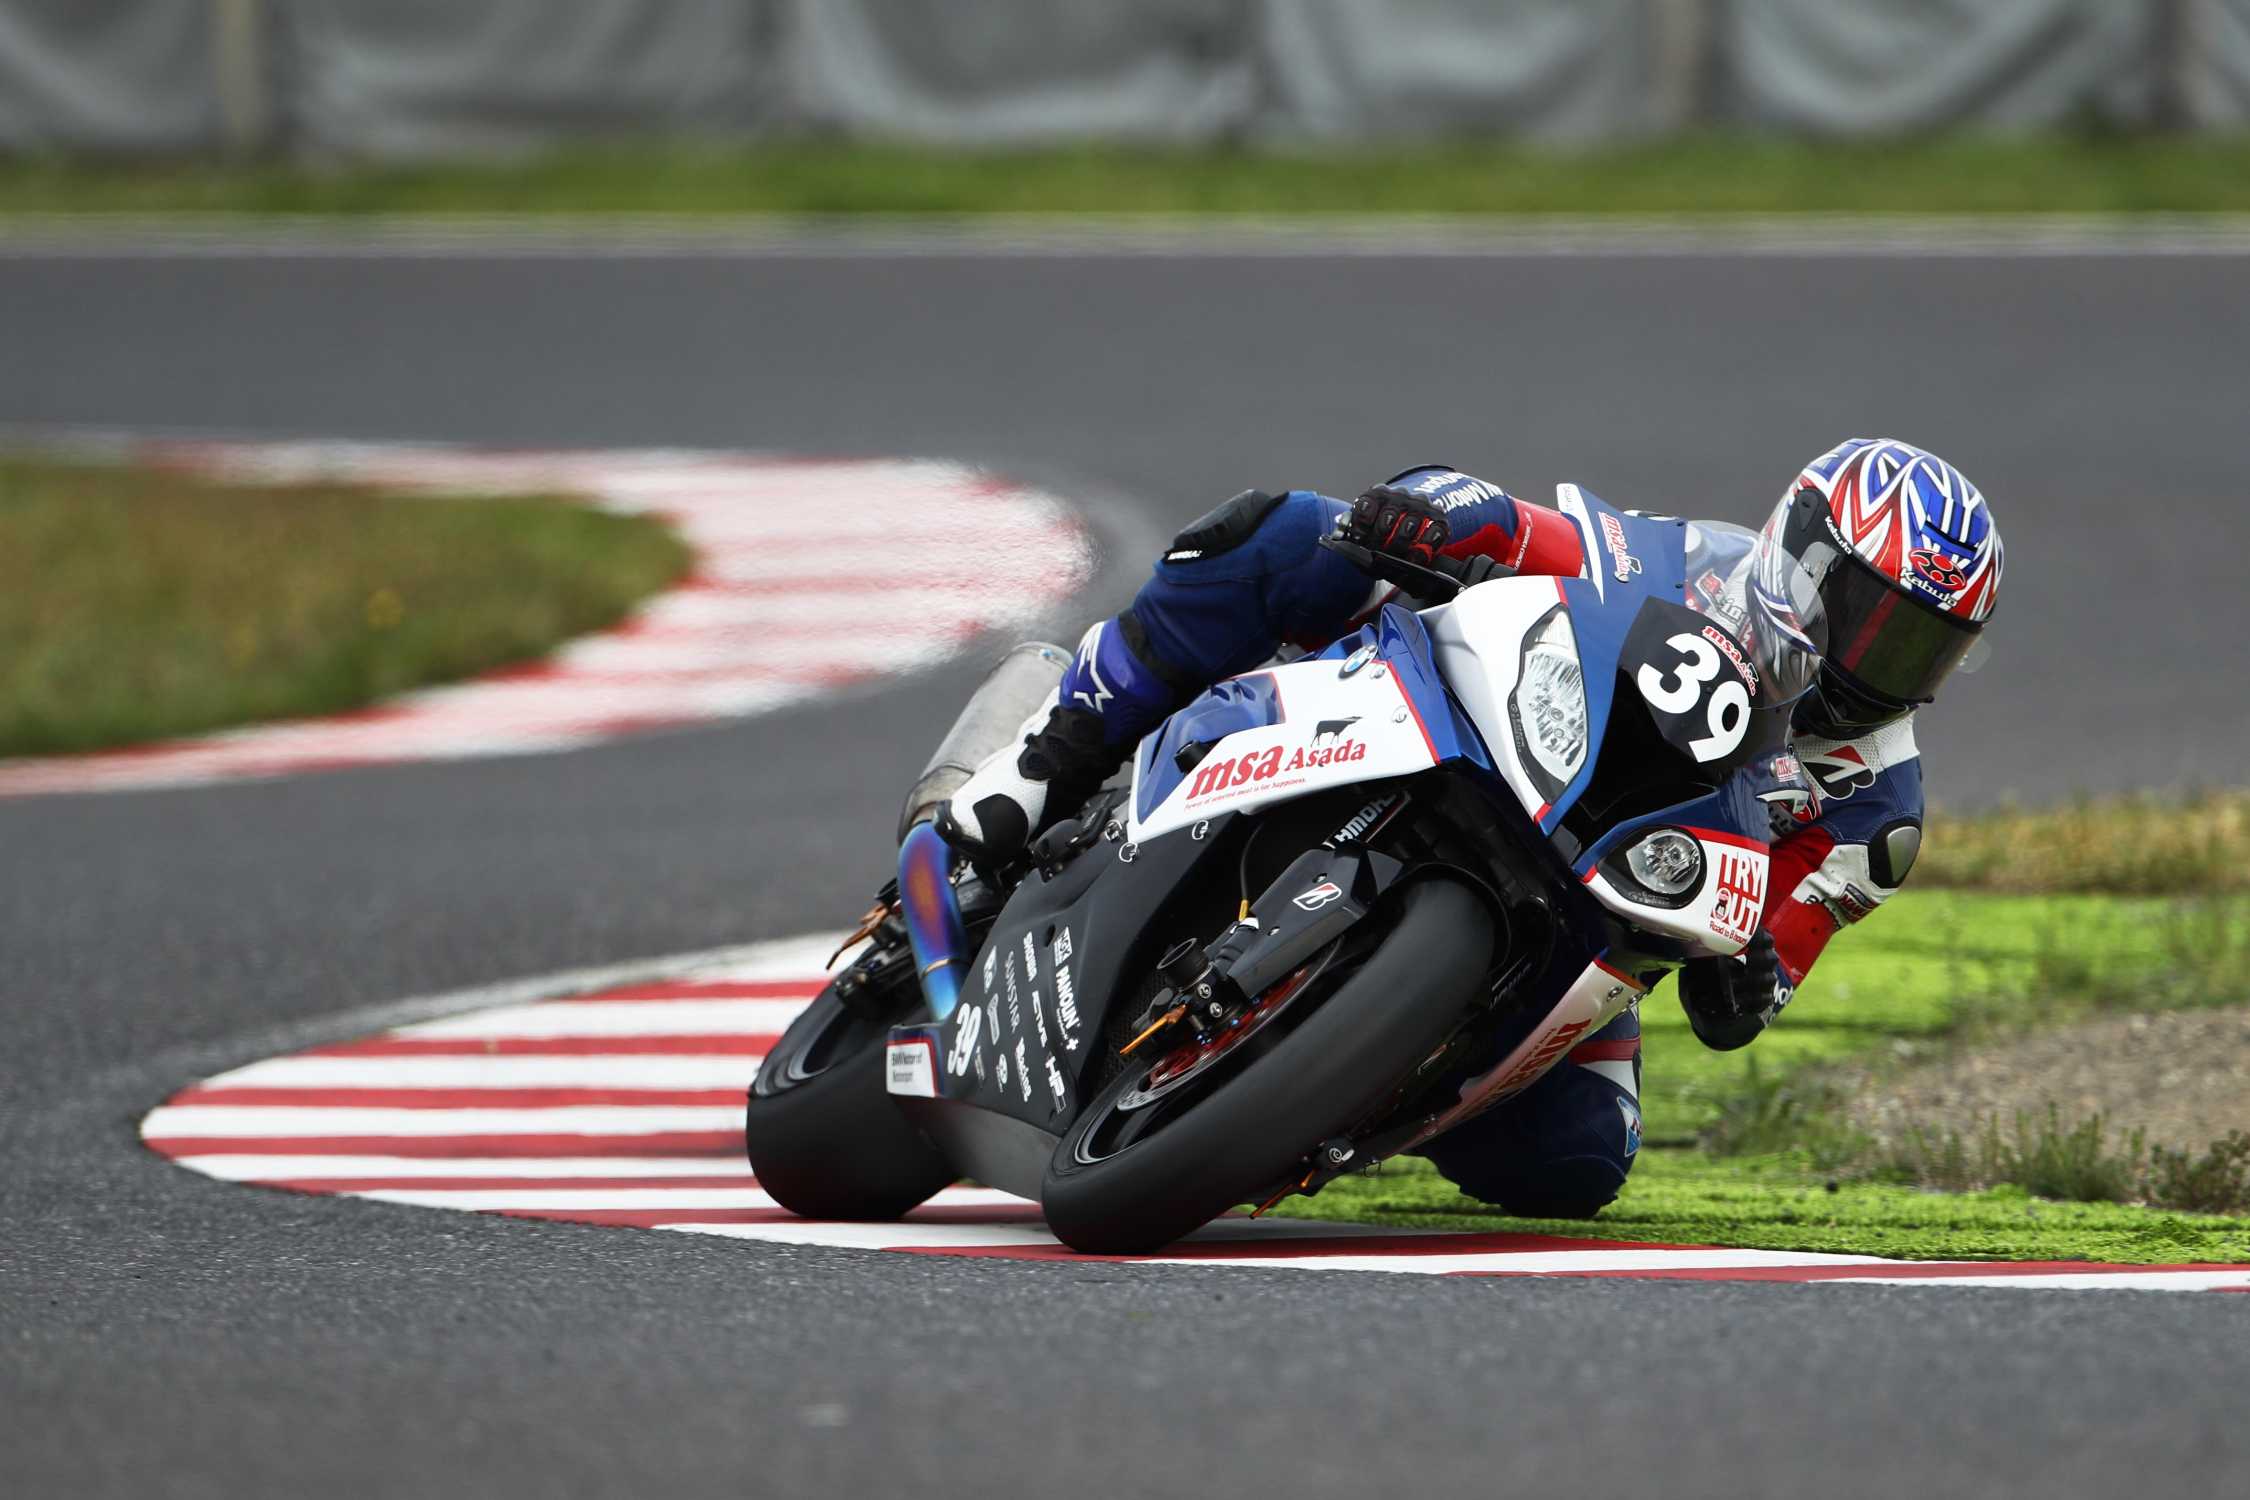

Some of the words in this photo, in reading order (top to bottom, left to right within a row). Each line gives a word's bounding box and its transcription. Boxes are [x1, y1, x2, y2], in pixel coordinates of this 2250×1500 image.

[1824, 516, 1852, 554] Kabuto
[1900, 567, 1957, 608] Kabuto
[1702, 626, 1744, 663] msa
[1637, 633, 1751, 763] 39
[1186, 745, 1284, 800] msa
[1284, 738, 1367, 771] Asada
[1723, 854, 1761, 895] TRY
[1712, 887, 1758, 935] OUT
[1005, 950, 1021, 1034] SUNSTAR
[1055, 965, 1079, 1030] PANOLIN
[947, 1002, 982, 1077] 39
